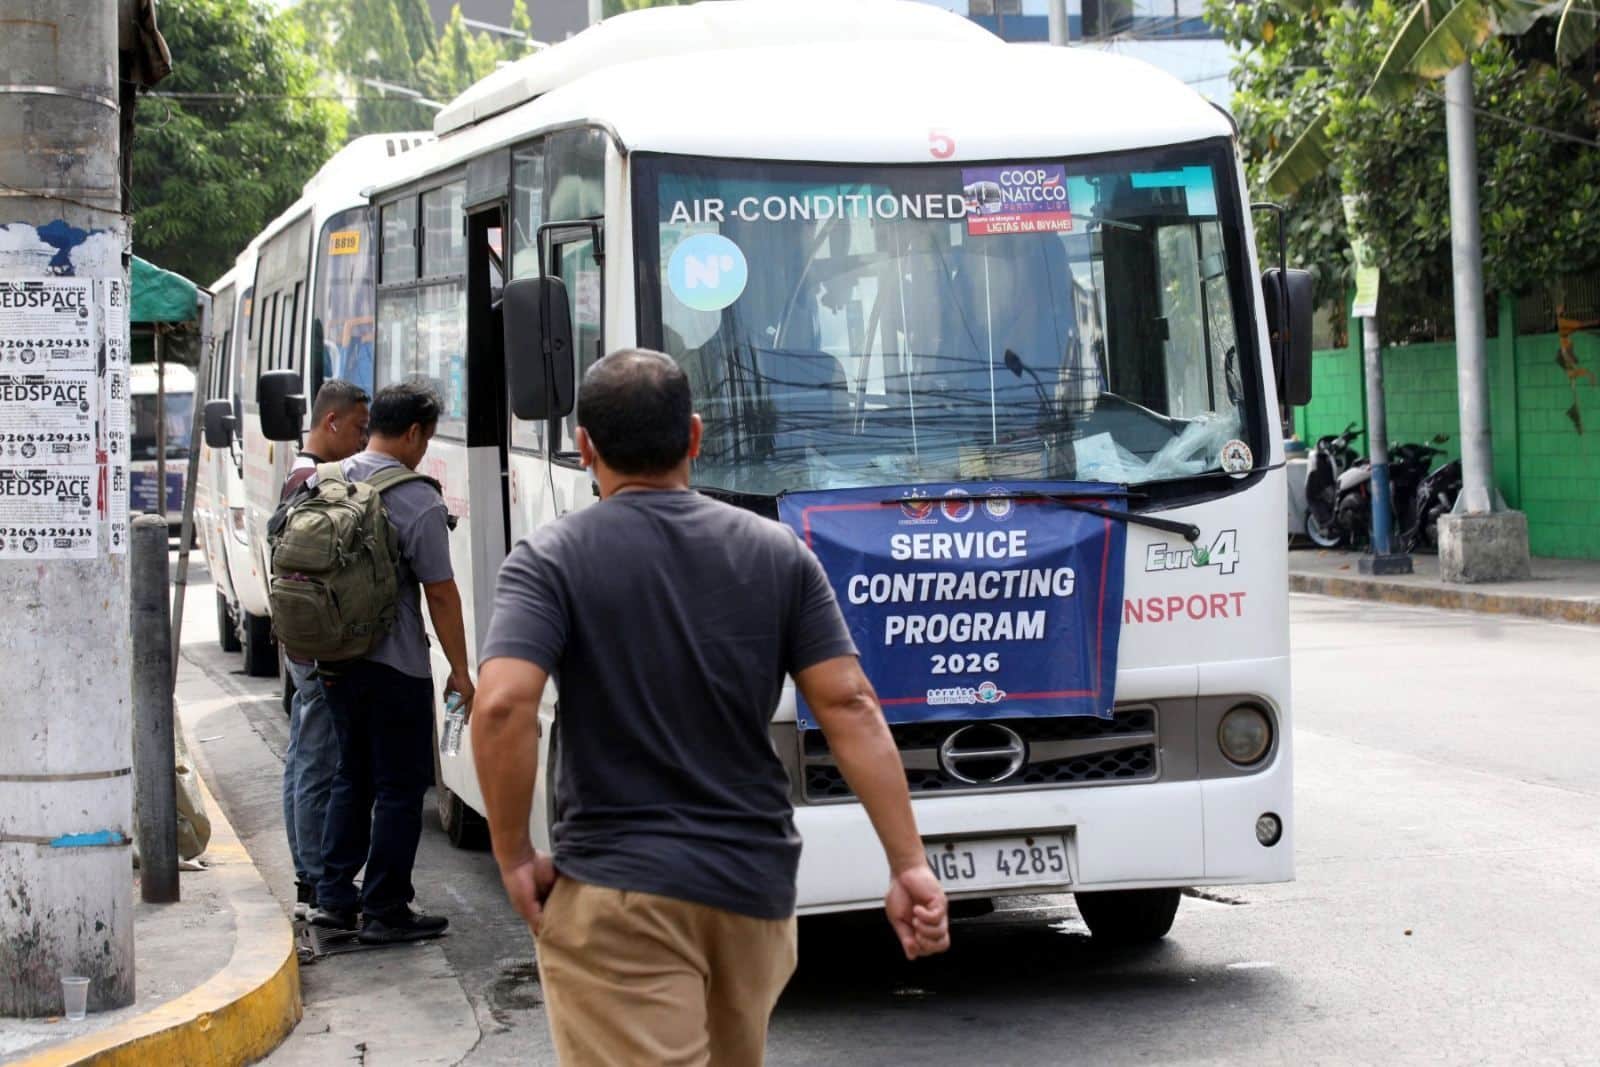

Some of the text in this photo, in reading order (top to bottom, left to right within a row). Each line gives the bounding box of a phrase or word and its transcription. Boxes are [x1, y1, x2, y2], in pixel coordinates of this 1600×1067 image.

[928, 127, 955, 160] 5
[1000, 170, 1046, 186] COOP
[1001, 186, 1066, 202] NATCCO
[987, 221, 1019, 232] LIGTAS
[1021, 219, 1035, 231] NA
[0, 291, 86, 308] EDSPACE
[0, 385, 87, 401] EDSPACE
[891, 530, 1027, 560] SERVICE
[847, 567, 1075, 605] CONTRACTING
[1124, 592, 1246, 624] NSPORT
[885, 610, 1047, 645] PROGRAM
[930, 653, 1000, 675] 2026
[925, 846, 1063, 881] NGJ 4285
